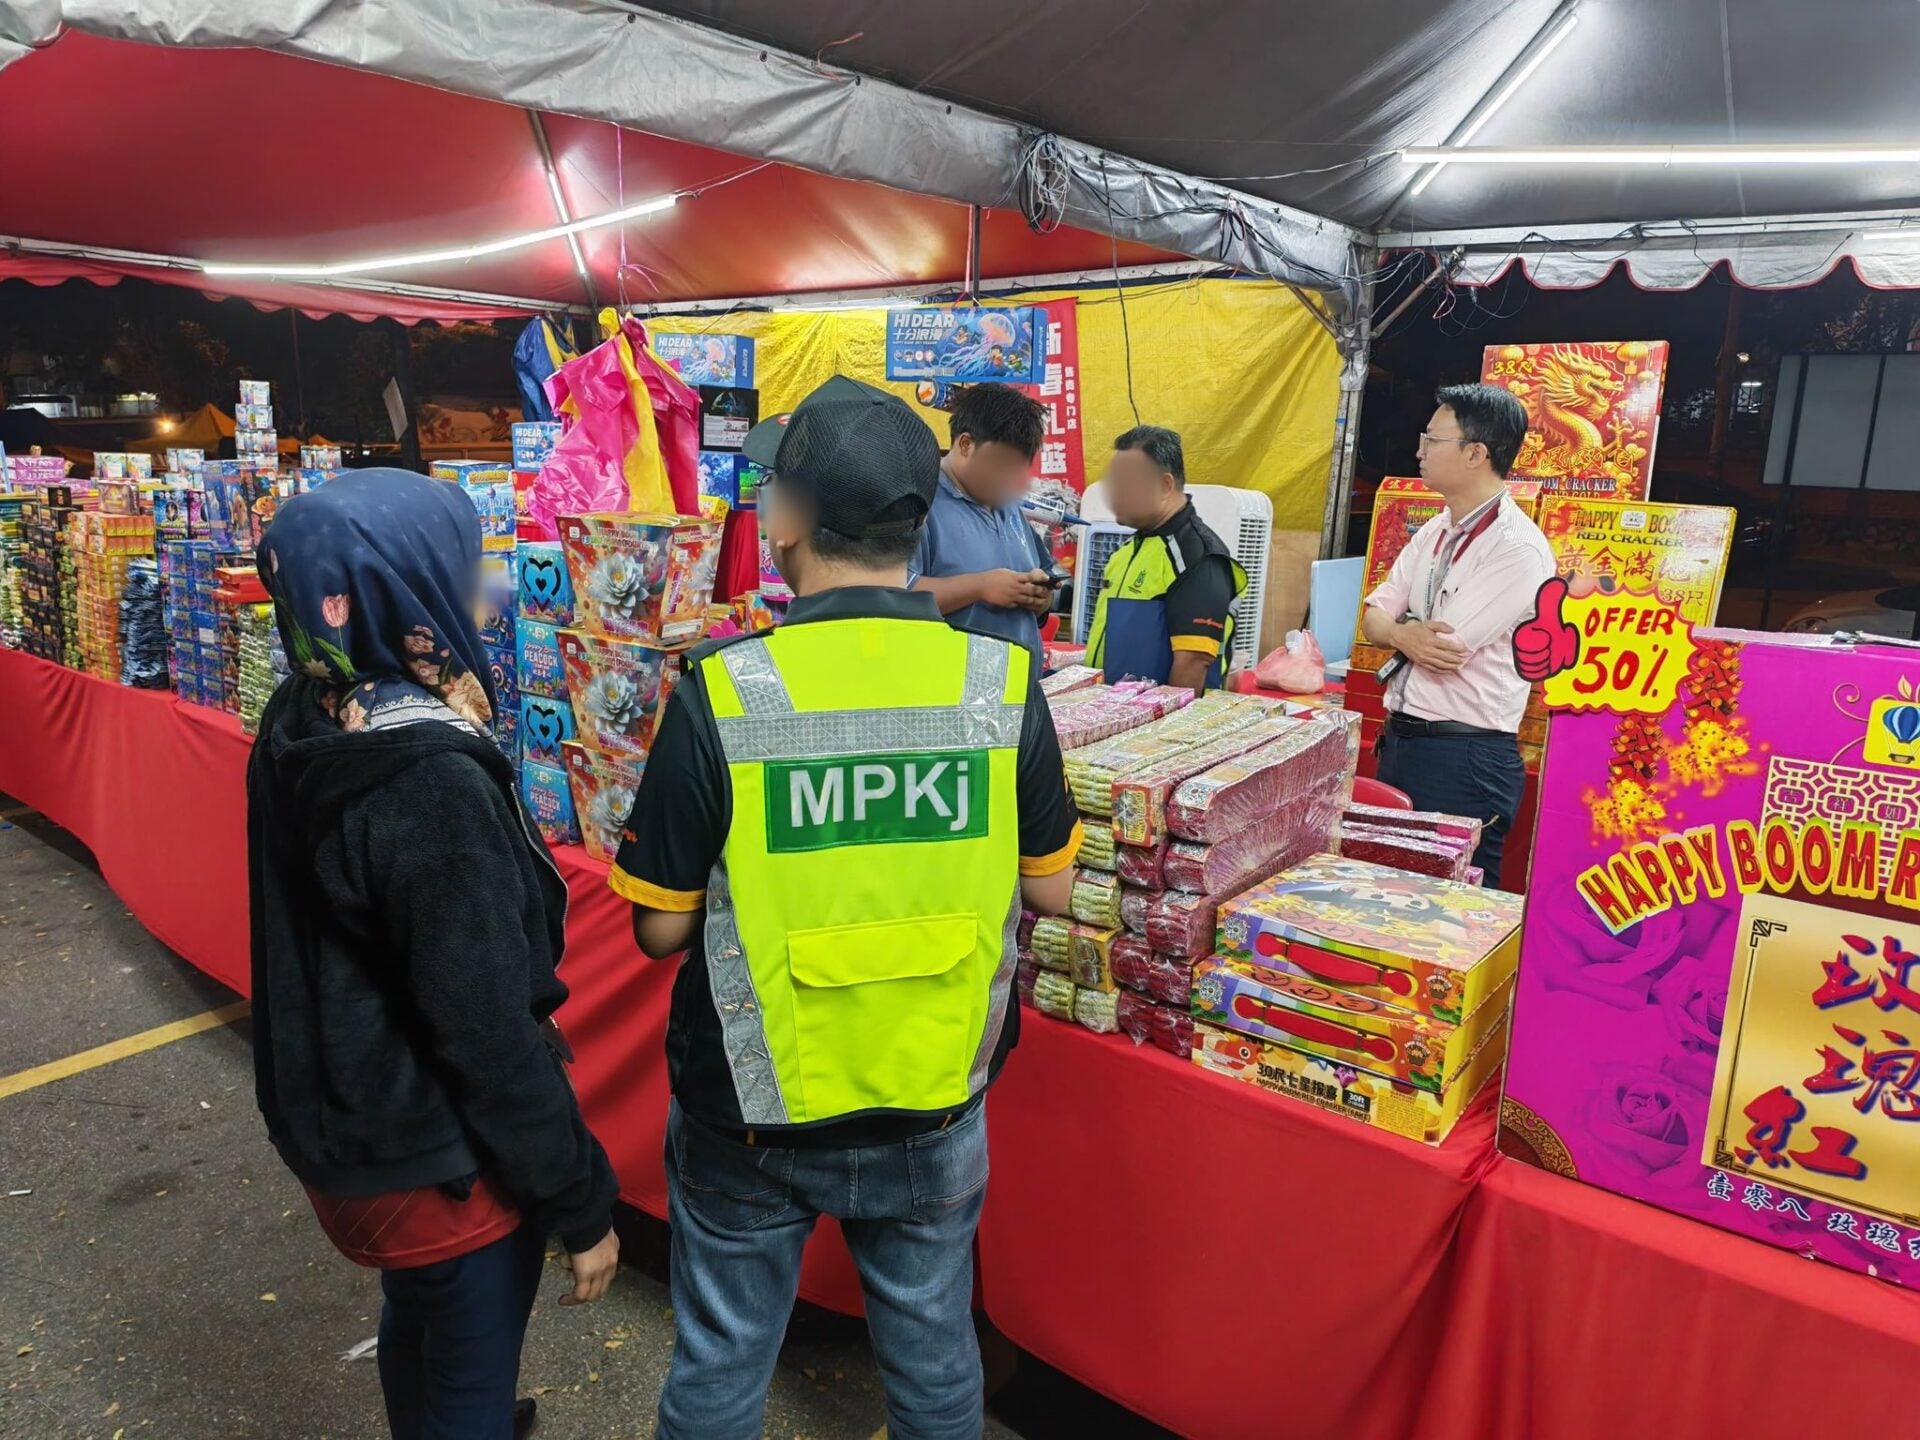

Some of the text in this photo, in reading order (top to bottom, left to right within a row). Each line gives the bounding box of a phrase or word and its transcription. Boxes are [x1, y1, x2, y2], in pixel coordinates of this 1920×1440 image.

[893, 313, 955, 328] HI DEAR
[658, 337, 693, 347] HI DEAR
[523, 428, 542, 438] DEAR
[1565, 478, 1617, 492] CRACKER
[1575, 510, 1619, 530] HAPPY
[1577, 531, 1685, 548] RED CRACKER
[1584, 607, 1675, 638] OFFER
[524, 650, 558, 667] PEACOCK
[1572, 644, 1669, 698] 50%
[789, 760, 969, 832] MPKj
[1579, 826, 1724, 930] HAPPY
[1729, 818, 1879, 896] BOOM
[1256, 1077, 1279, 1091] HAPPY
[1278, 1086, 1301, 1098] BOOM
[1301, 1093, 1316, 1103] RED
[1315, 1097, 1348, 1113] CRACKER
[1348, 1092, 1366, 1103] 30ft
